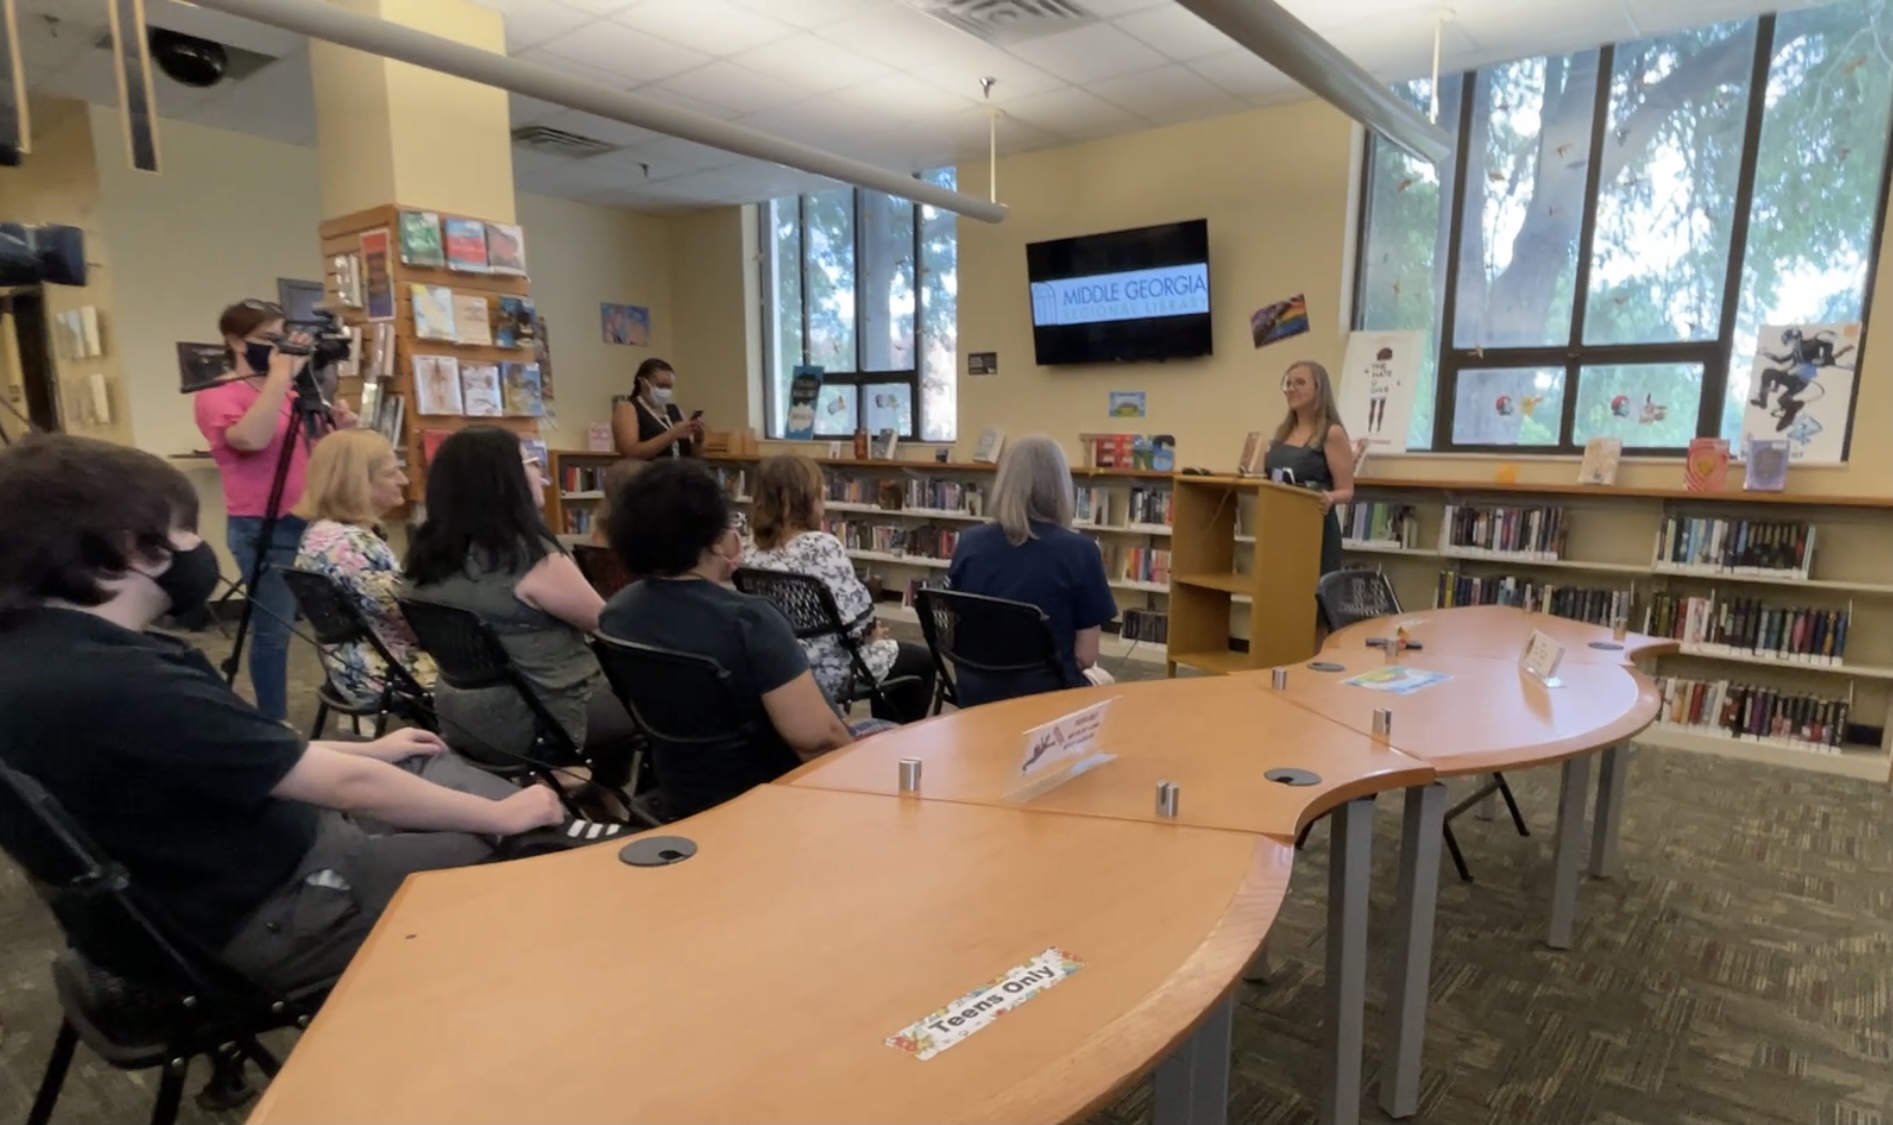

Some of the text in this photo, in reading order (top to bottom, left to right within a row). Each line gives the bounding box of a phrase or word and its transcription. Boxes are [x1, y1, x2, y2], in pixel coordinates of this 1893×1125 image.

[1063, 275, 1207, 306] MIDDLE GEORGIA
[1063, 297, 1208, 321] REGIONAL LIBRARY
[1372, 370, 1392, 378] HATE
[928, 965, 1056, 1035] Teens Only
